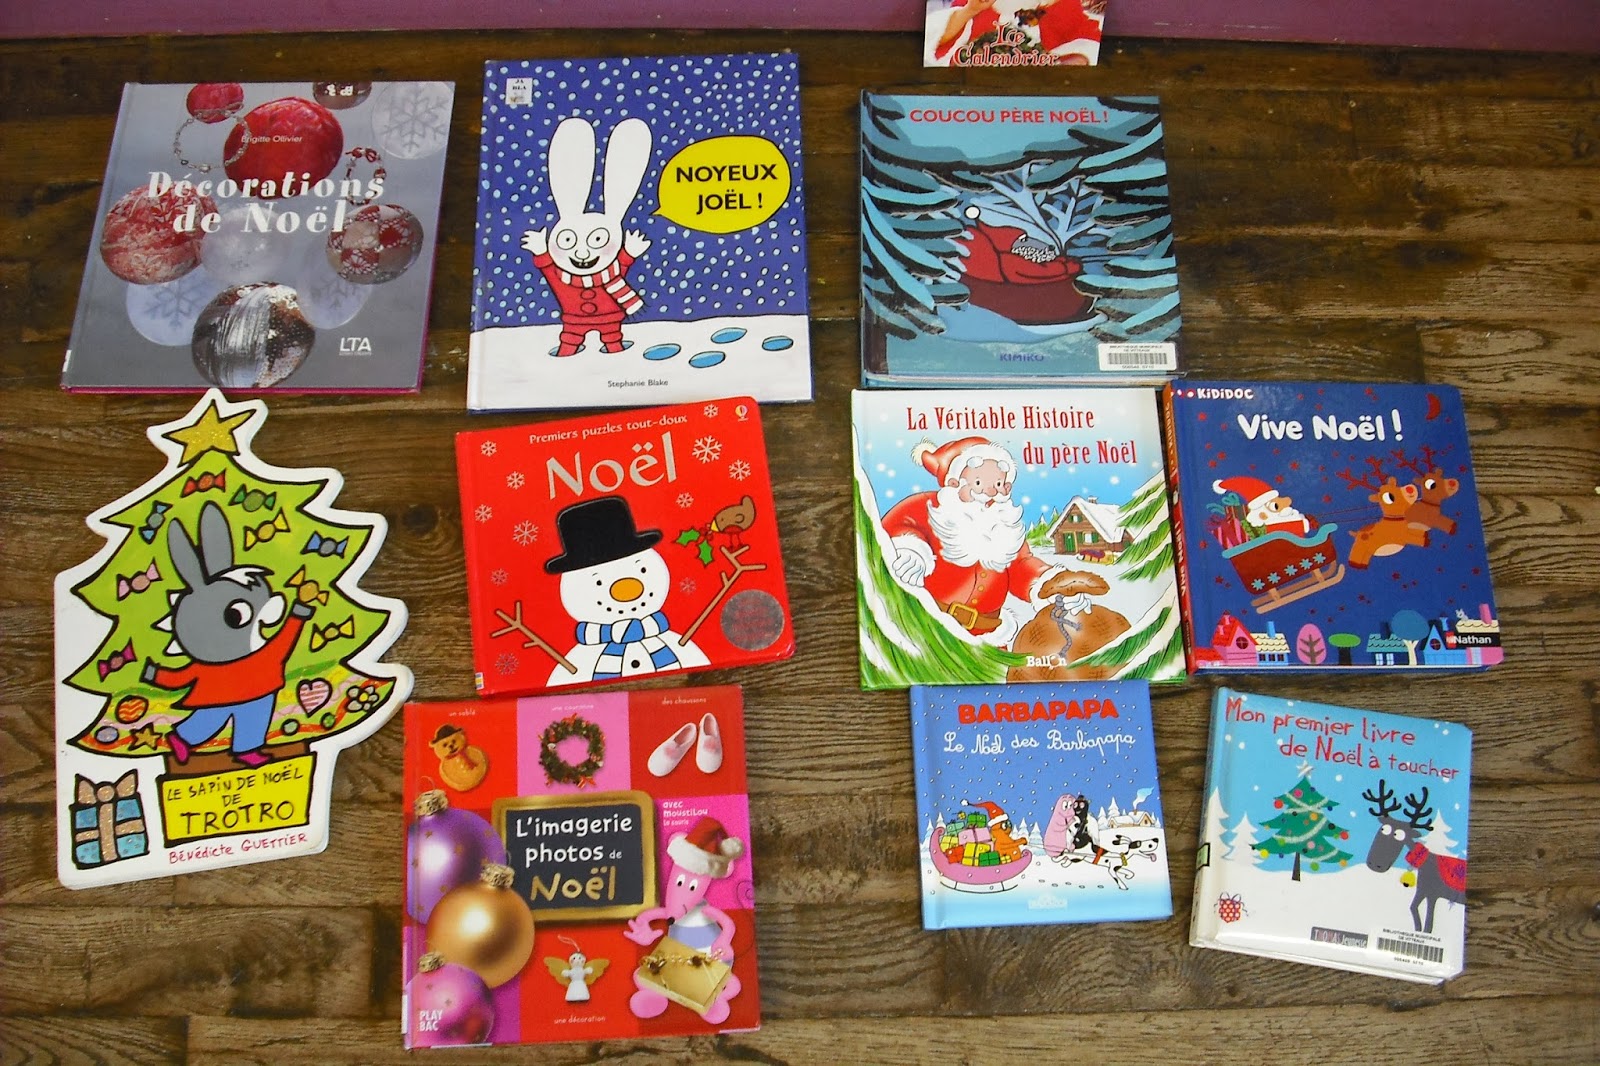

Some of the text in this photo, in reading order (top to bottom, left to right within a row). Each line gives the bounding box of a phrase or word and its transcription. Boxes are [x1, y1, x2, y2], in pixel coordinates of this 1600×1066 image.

[953, 42, 1059, 67] Calendrier
[909, 108, 995, 124] COUCOU
[1000, 105, 1045, 123] PÈRE
[1050, 106, 1101, 123] NOËL
[148, 171, 384, 200] Décorations
[676, 164, 779, 183] NOYEUX
[696, 189, 752, 215] JOËL
[173, 200, 347, 233] de Noël
[340, 337, 372, 352] LTA
[1000, 352, 1045, 362] KIMIKO
[607, 378, 669, 389] Stephanie Blake
[529, 414, 688, 444] Premiers puzzles tout-doux
[907, 405, 1095, 431] La Véritable Histoire
[1237, 413, 1303, 441] Vive
[1312, 414, 1385, 442] Noël
[546, 431, 678, 500] Noël
[1023, 440, 1138, 468] du père Noël
[1454, 635, 1492, 645] Nathan
[957, 698, 1119, 724] BARBAPAPA
[1225, 696, 1415, 746] Mon premier livre
[943, 731, 965, 753] Le
[1010, 734, 1040, 749] des
[1046, 729, 1136, 756] Barbapapa
[1279, 734, 1460, 780] de Noël à toucher
[167, 788, 182, 801] LE
[237, 775, 256, 791] DE
[263, 764, 303, 785] NOËL
[222, 793, 242, 808] DE
[663, 801, 683, 809] avec
[180, 800, 294, 834] TROTRO
[516, 814, 633, 839] L'imagerie
[525, 844, 623, 868] photos de
[530, 865, 617, 902] Noël
[1314, 929, 1341, 945] TOA
[419, 1020, 439, 1031] BAC
[420, 1009, 443, 1020] PLAY
